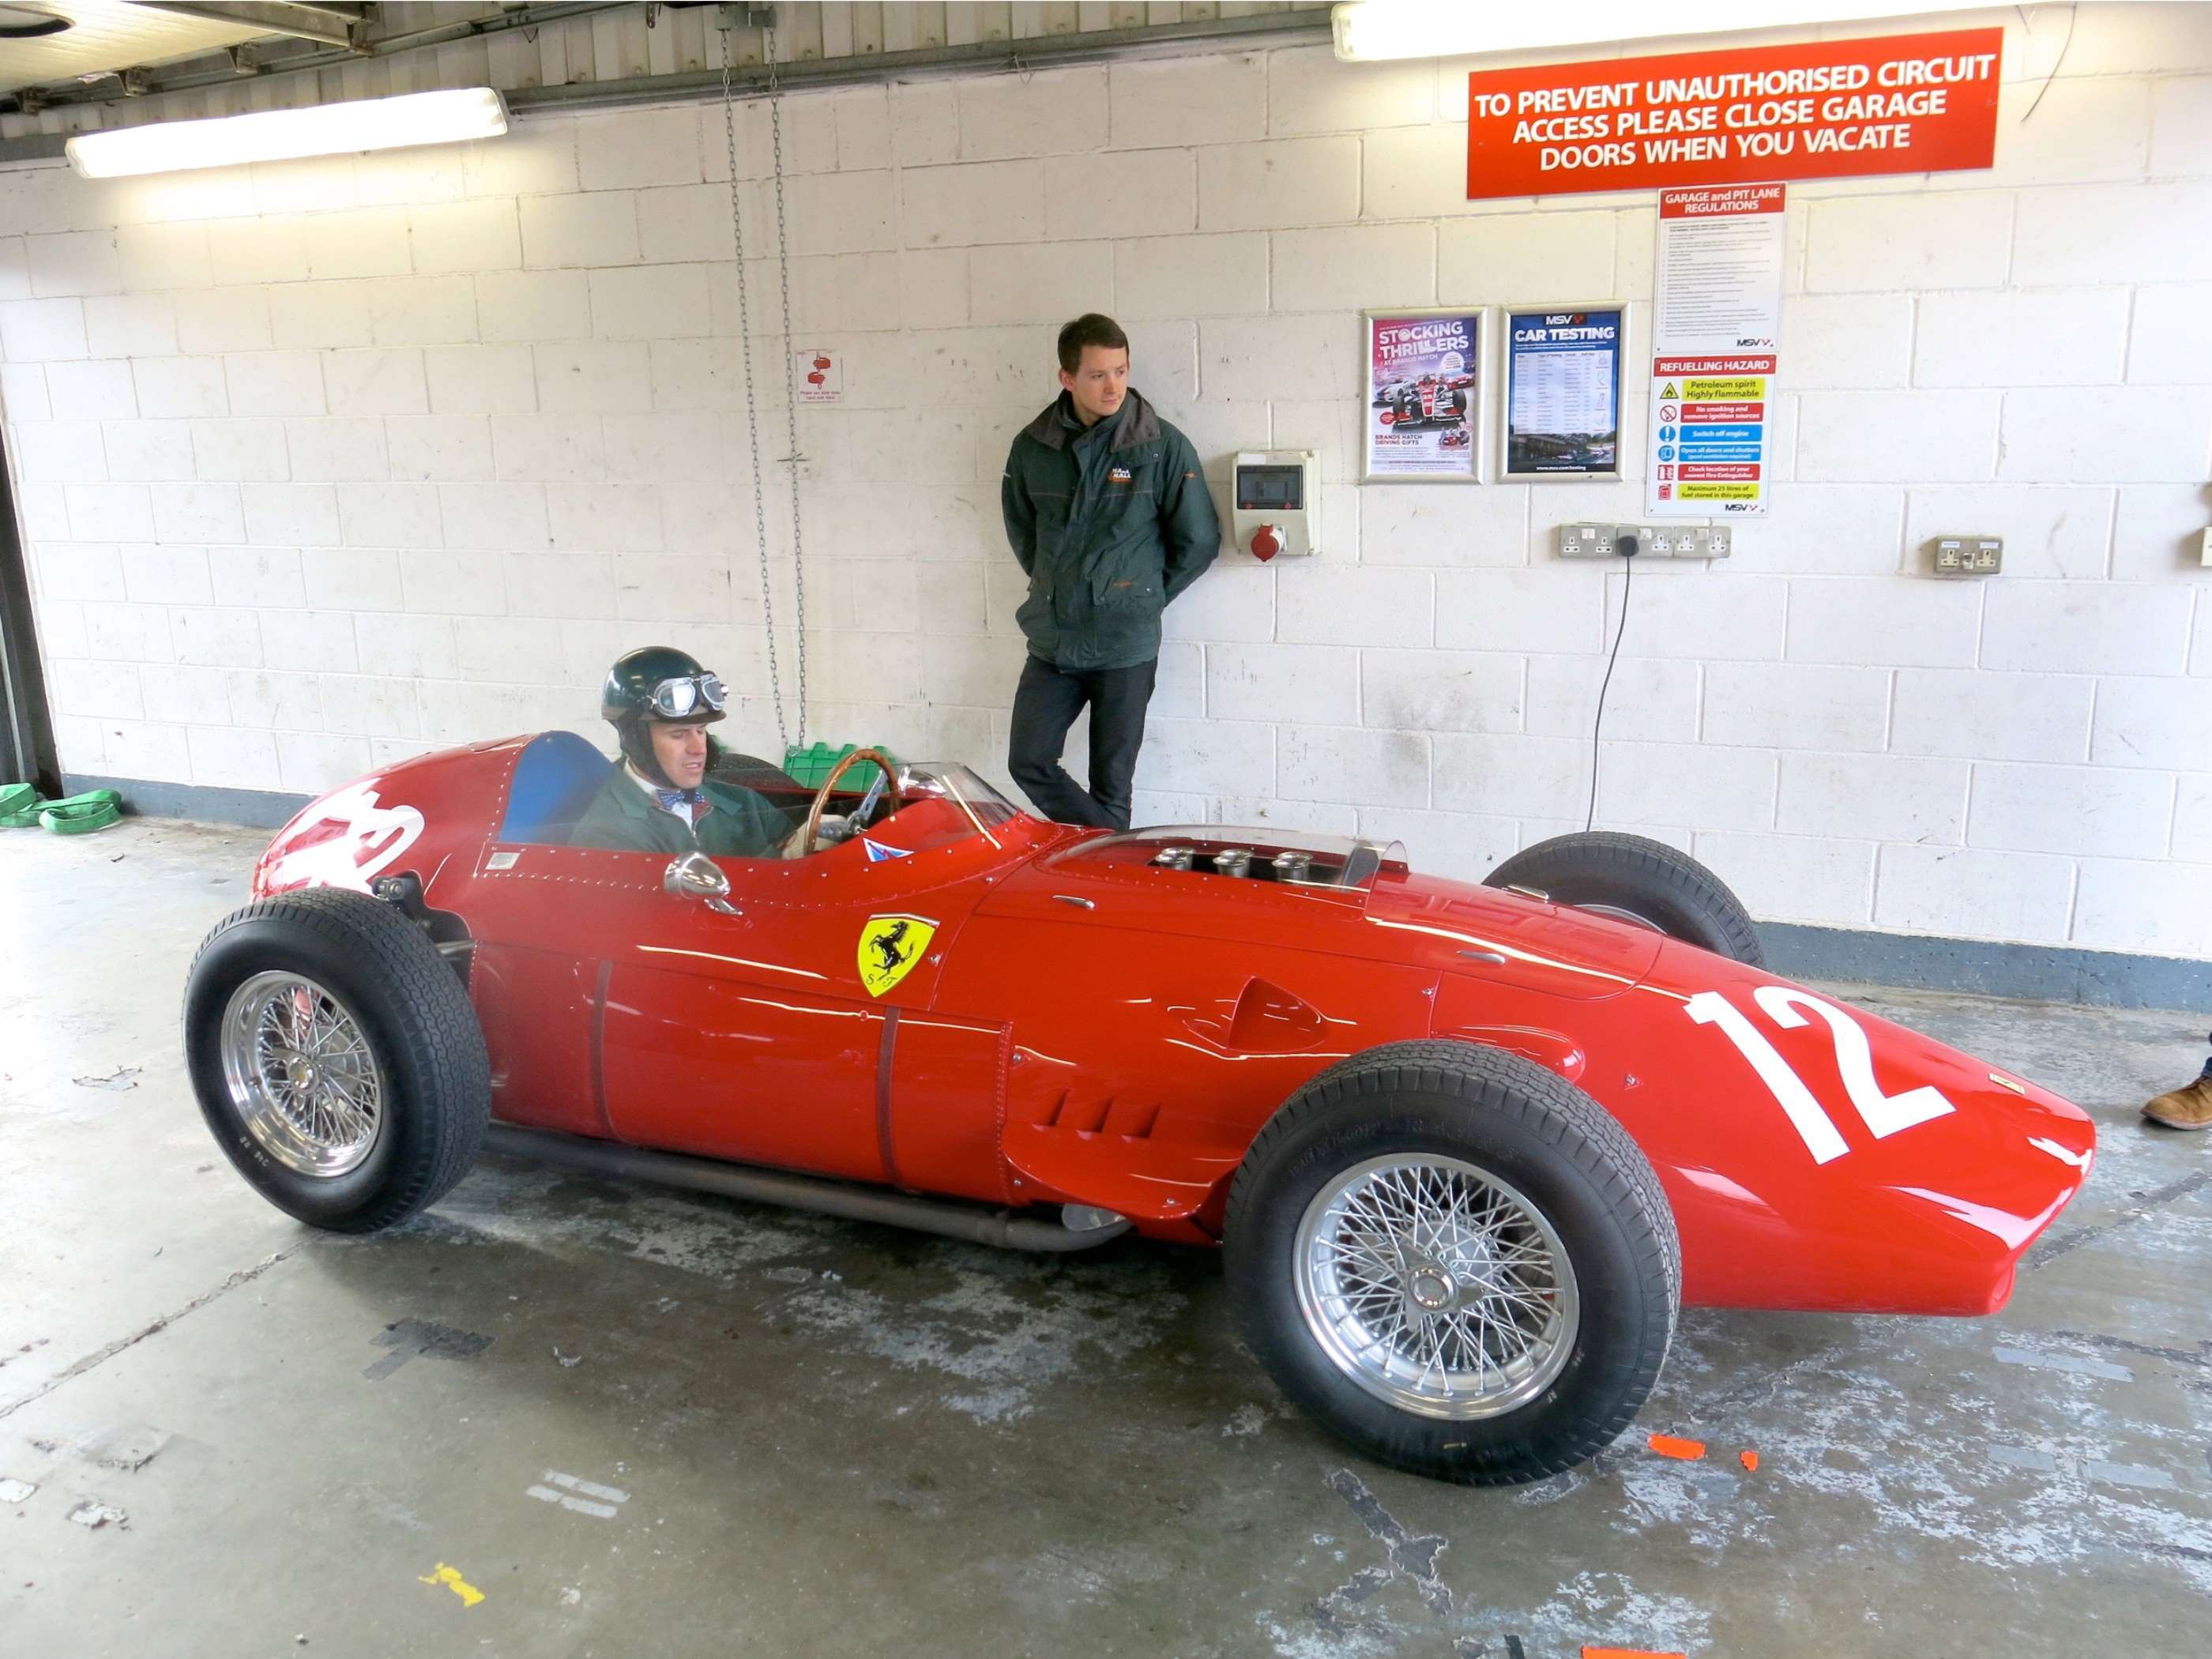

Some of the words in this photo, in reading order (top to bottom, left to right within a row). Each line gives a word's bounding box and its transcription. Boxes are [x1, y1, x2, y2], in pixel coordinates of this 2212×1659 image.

[1475, 94, 1510, 118] TO
[1518, 82, 1638, 115] PREVENT
[1646, 63, 1869, 104] UNAUTHORISED
[1876, 54, 1996, 87] CIRCUIT
[1513, 111, 1608, 144] ACCESS
[1617, 105, 1717, 137] PLEASE
[1725, 100, 1814, 129] CLOSE
[1821, 90, 1947, 122] GARAGE
[1540, 143, 1636, 171] DOORS
[1644, 137, 1727, 165] WHEN
[1734, 133, 1794, 158] YOU
[1802, 123, 1910, 152] VACATE
[1665, 191, 1710, 204] GARAGE
[1711, 190, 1732, 201] and
[1733, 189, 1750, 199] PIT
[1751, 187, 1780, 198] LANE
[1684, 200, 1759, 213] REGULATIONS
[1545, 315, 1573, 325] MSV
[1379, 321, 1464, 344] STOCKING
[1514, 329, 1547, 342] CAR
[1548, 326, 1615, 341] TESTING
[1379, 335, 1469, 359] THRILLERS
[1660, 362, 1722, 372] REFUELLING
[1724, 360, 1770, 371] HAZARD
[1735, 381, 1756, 389] spirit
[1687, 390, 1713, 400] Highly
[1683, 985, 1957, 1165] 12
